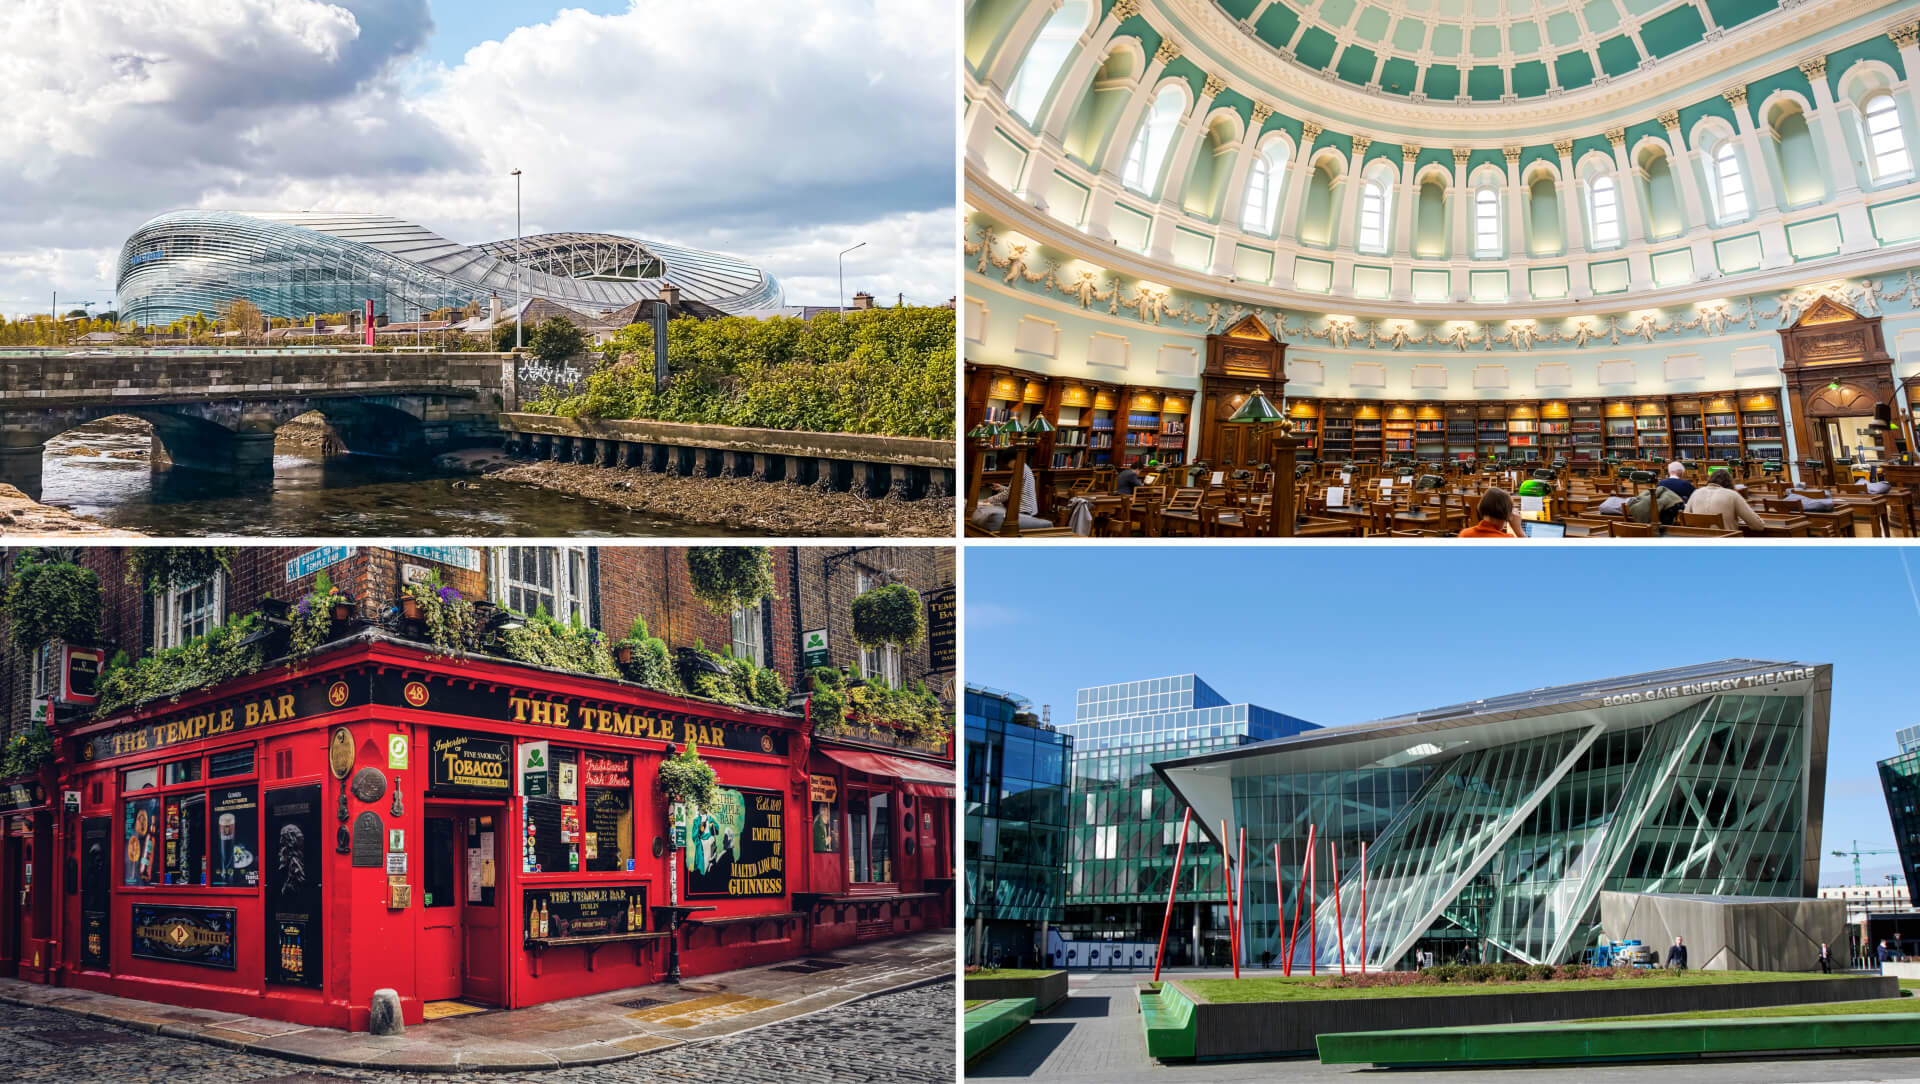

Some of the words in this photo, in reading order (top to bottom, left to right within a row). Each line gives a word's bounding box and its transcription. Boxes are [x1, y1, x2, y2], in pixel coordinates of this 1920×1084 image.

[408, 686, 424, 701] 48
[1603, 692, 1641, 707] BORD
[1645, 687, 1678, 701] GÁIS
[1682, 678, 1741, 696] ENERGY
[1745, 667, 1815, 687] THEATRE
[331, 686, 345, 703] 48
[112, 730, 148, 754] THE
[153, 709, 235, 745] TEMPLE
[245, 694, 296, 727] BAR
[510, 697, 570, 727] THE
[579, 706, 674, 741] TEMPLE
[684, 722, 725, 747] BAR
[586, 760, 628, 772] Traditional
[586, 772, 604, 784] Irish
[609, 775, 630, 787] Music
[720, 793, 733, 804] THE
[720, 815, 734, 825] BAR
[768, 814, 781, 828] THE
[752, 827, 782, 841] EMPEROR
[774, 842, 781, 856] OF
[731, 863, 757, 877] MALTED
[729, 878, 782, 894] GUINNESS
[550, 891, 570, 903] THE
[572, 889, 608, 902] TEMPLE
[610, 889, 626, 901] BAR
